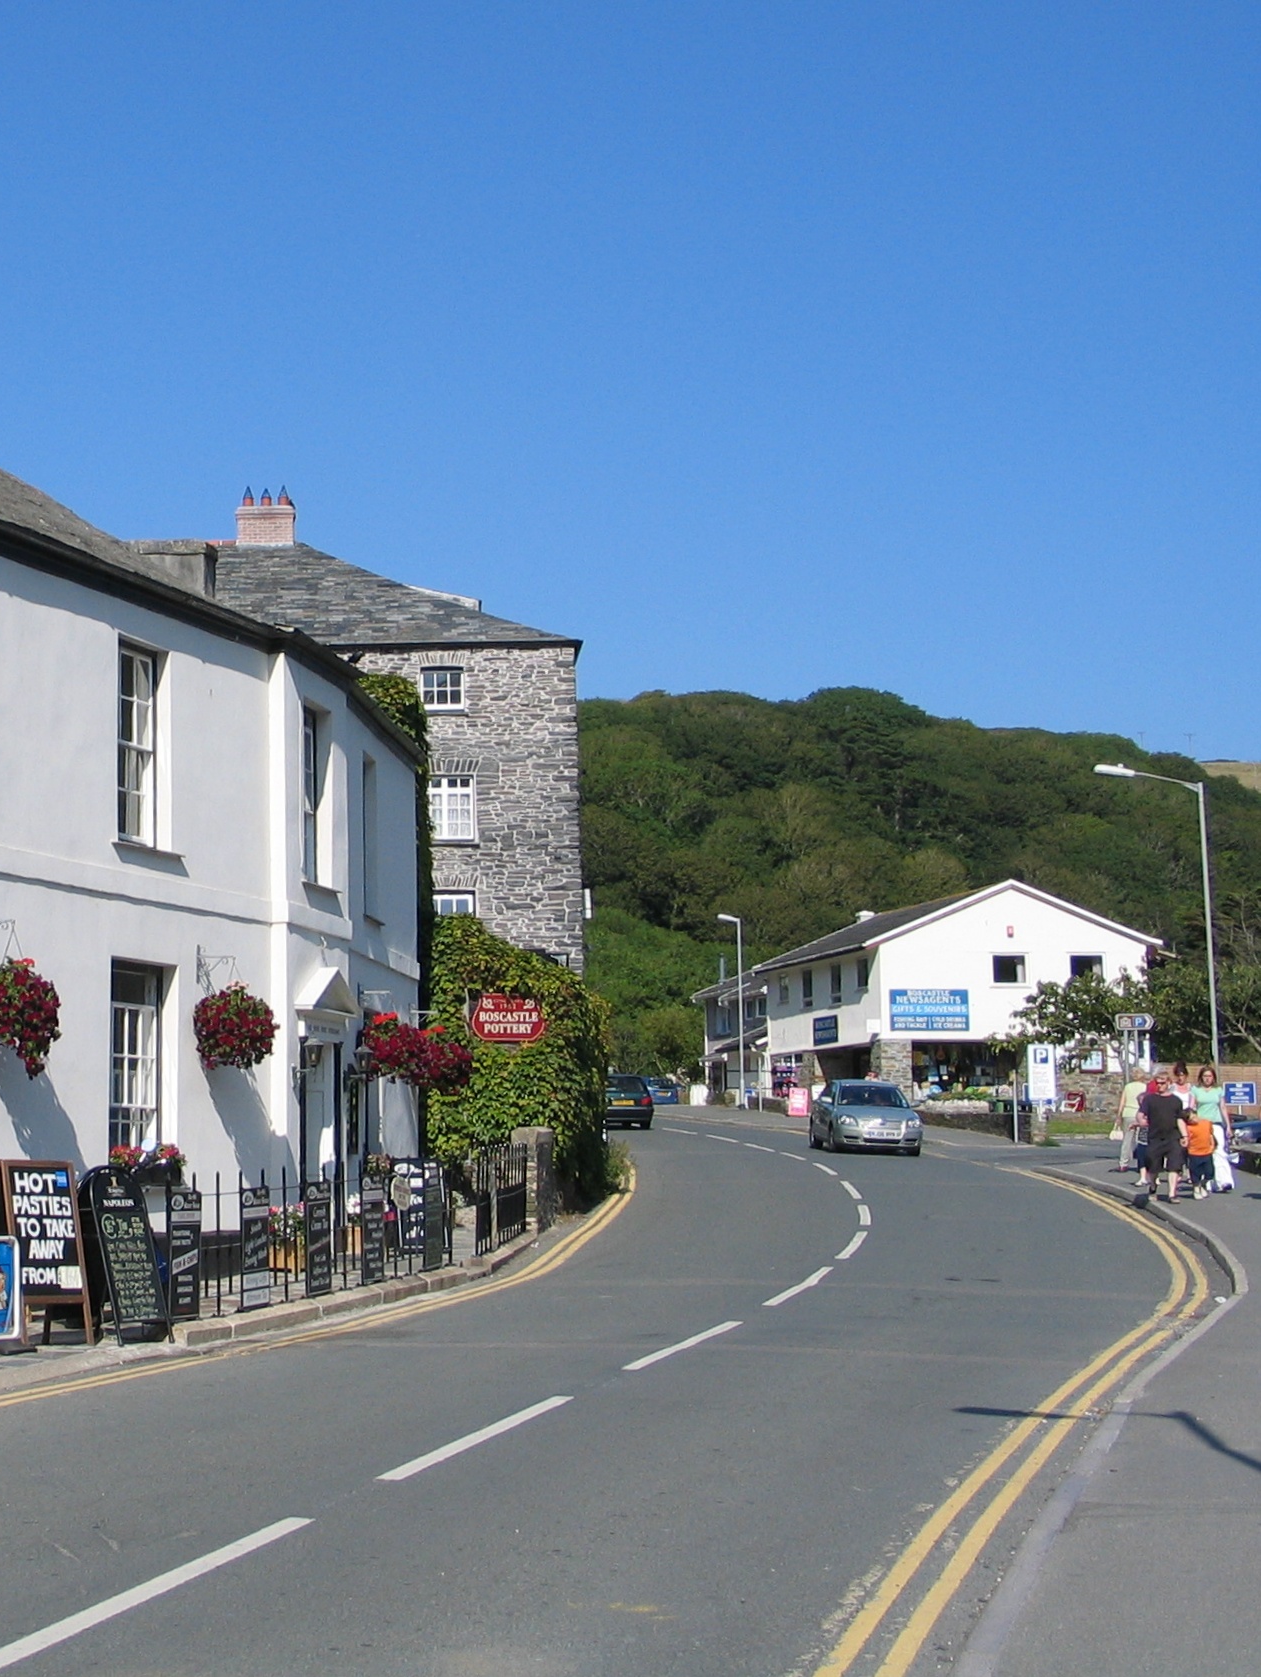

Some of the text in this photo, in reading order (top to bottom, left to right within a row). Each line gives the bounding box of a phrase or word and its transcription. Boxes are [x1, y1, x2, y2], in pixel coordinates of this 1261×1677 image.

[896, 996, 961, 1004] NEWSAGENTS
[479, 1012, 539, 1022] BOSCASTLE
[892, 1005, 967, 1013] GIFTS & SOUVENIRS
[484, 1024, 533, 1034] POTTERY
[1036, 1049, 1046, 1064] P
[13, 1171, 56, 1194] HOT
[12, 1194, 72, 1216] PASTIES
[16, 1217, 75, 1238] TO TAKE
[28, 1239, 64, 1260] AWAY
[22, 1266, 56, 1284] FROM
